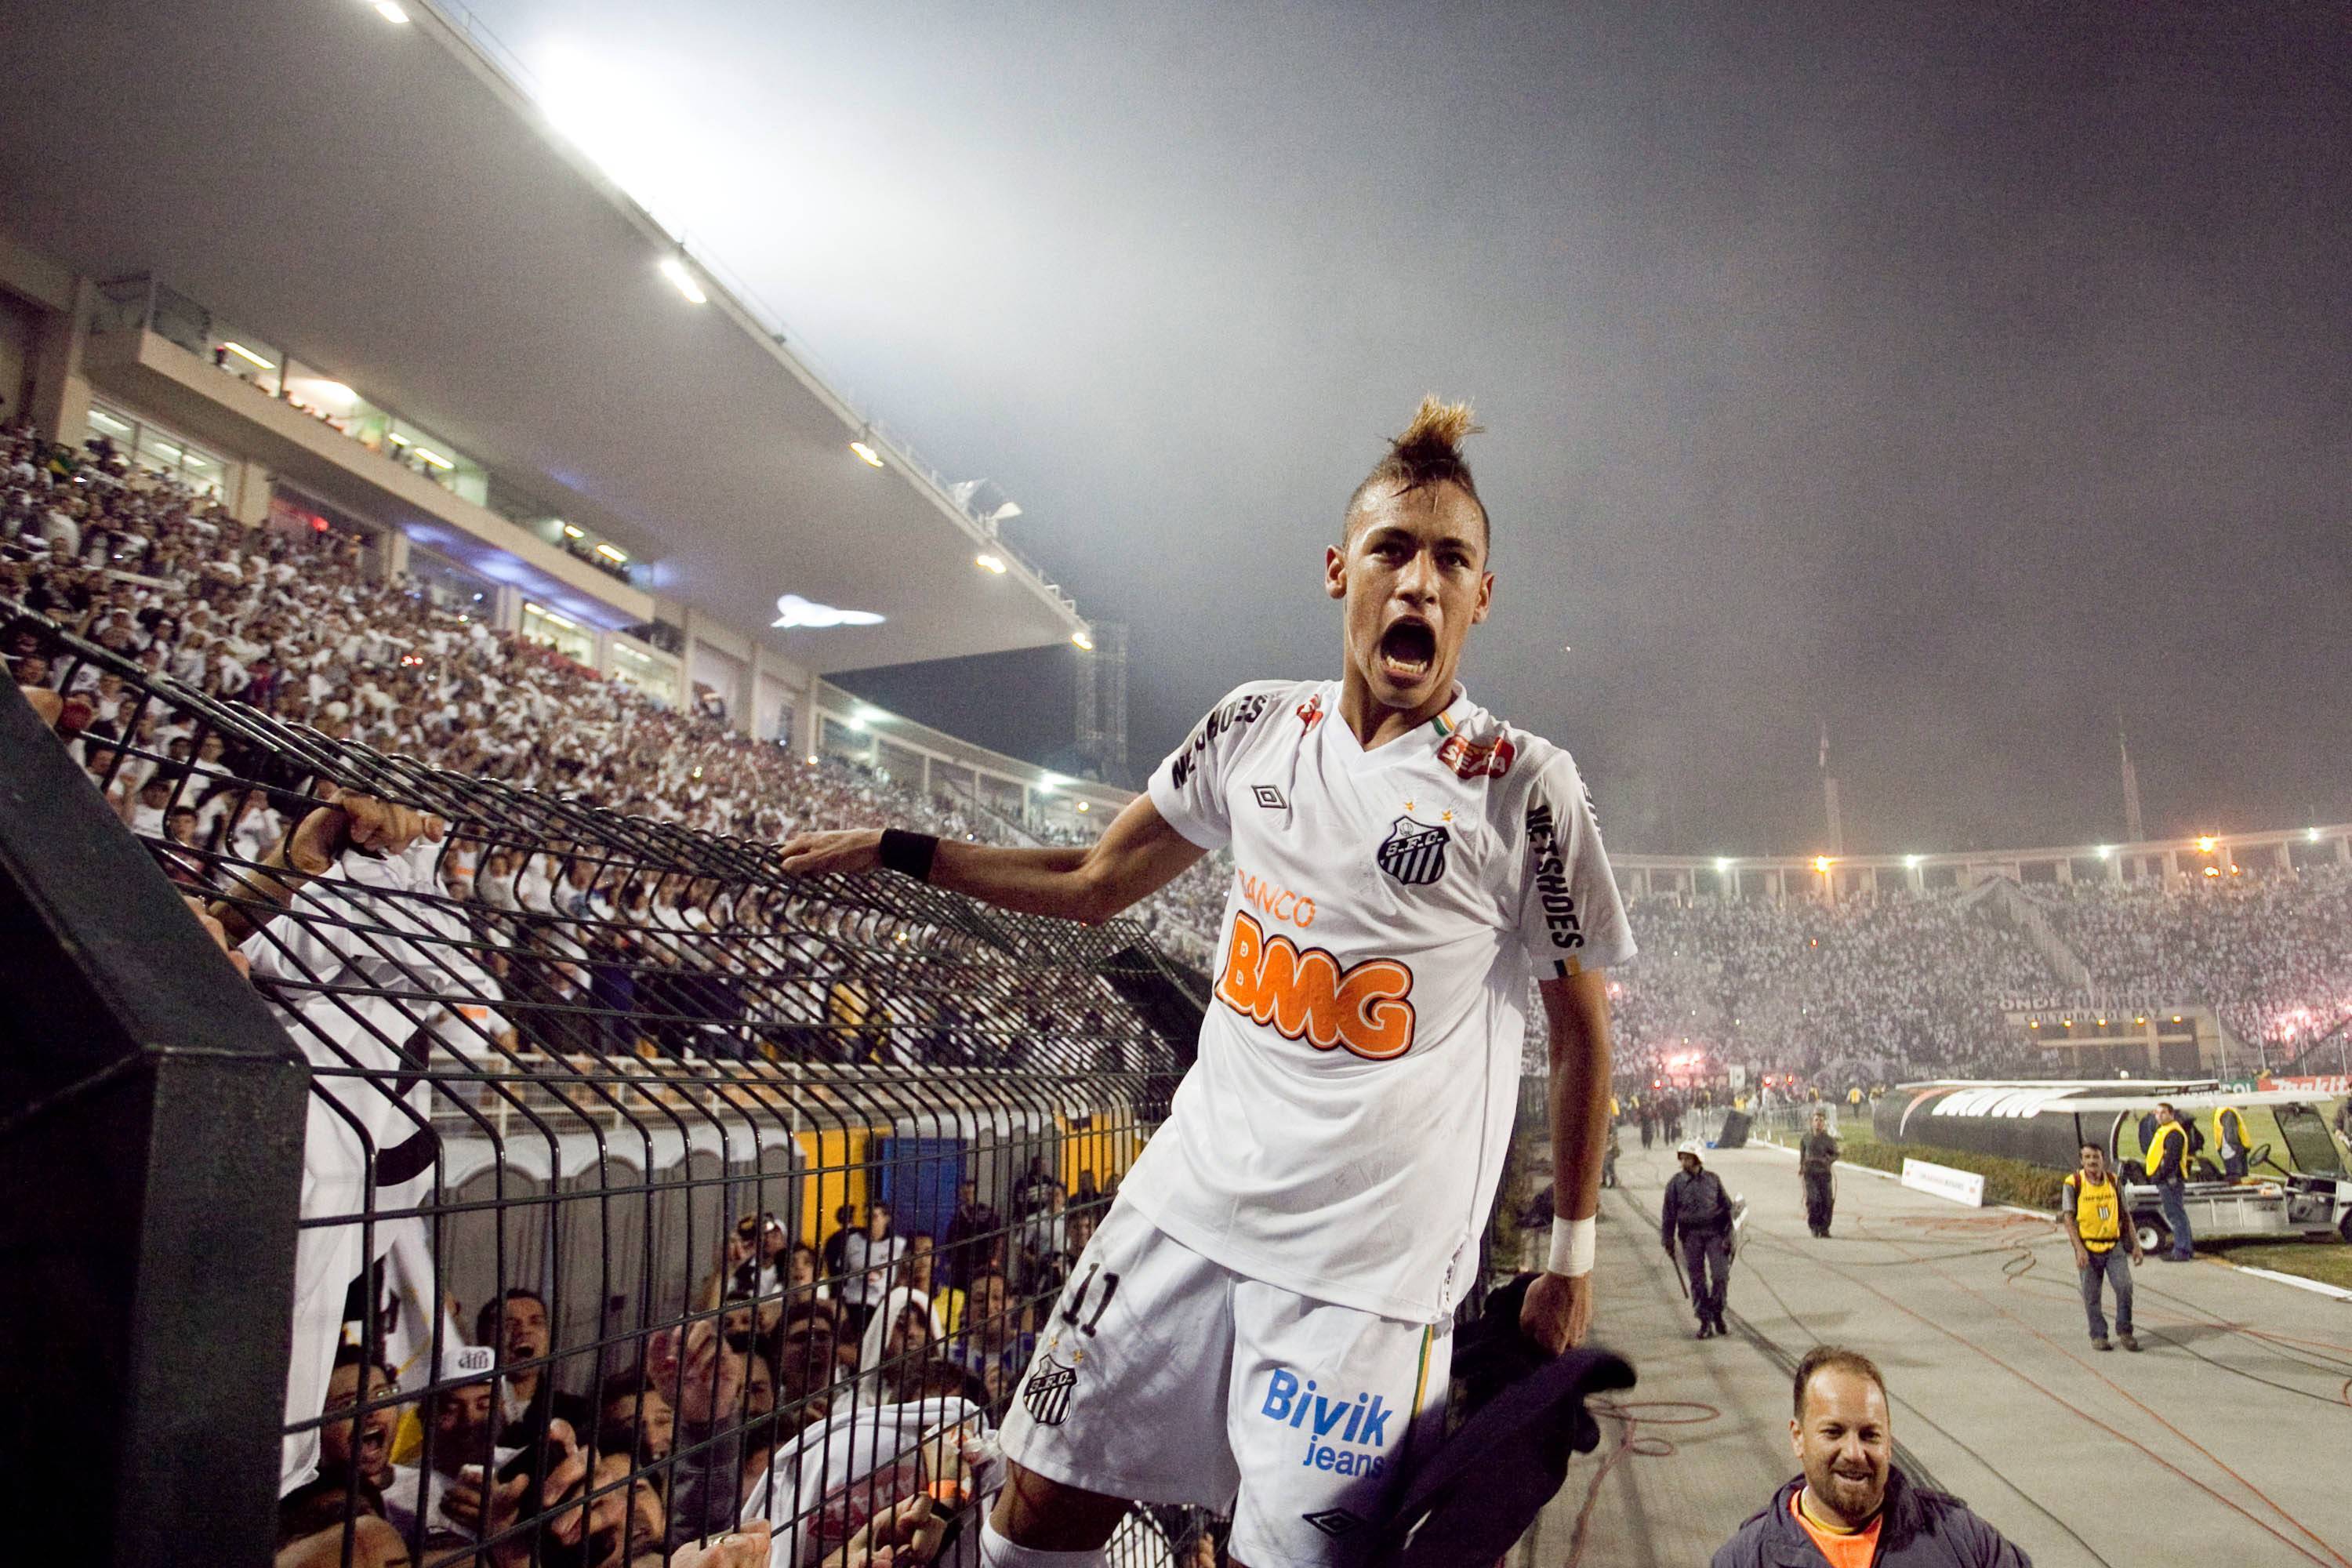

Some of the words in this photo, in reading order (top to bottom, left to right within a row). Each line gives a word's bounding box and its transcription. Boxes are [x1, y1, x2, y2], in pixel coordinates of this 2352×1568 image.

[1238, 868, 1316, 928] ANCO
[1526, 805, 1584, 949] NETSHOES
[1214, 909, 1416, 1062] BMG
[1062, 1262, 1120, 1338] 11
[1261, 1368, 1393, 1446] Bivik
[1303, 1435, 1385, 1479] jeans
